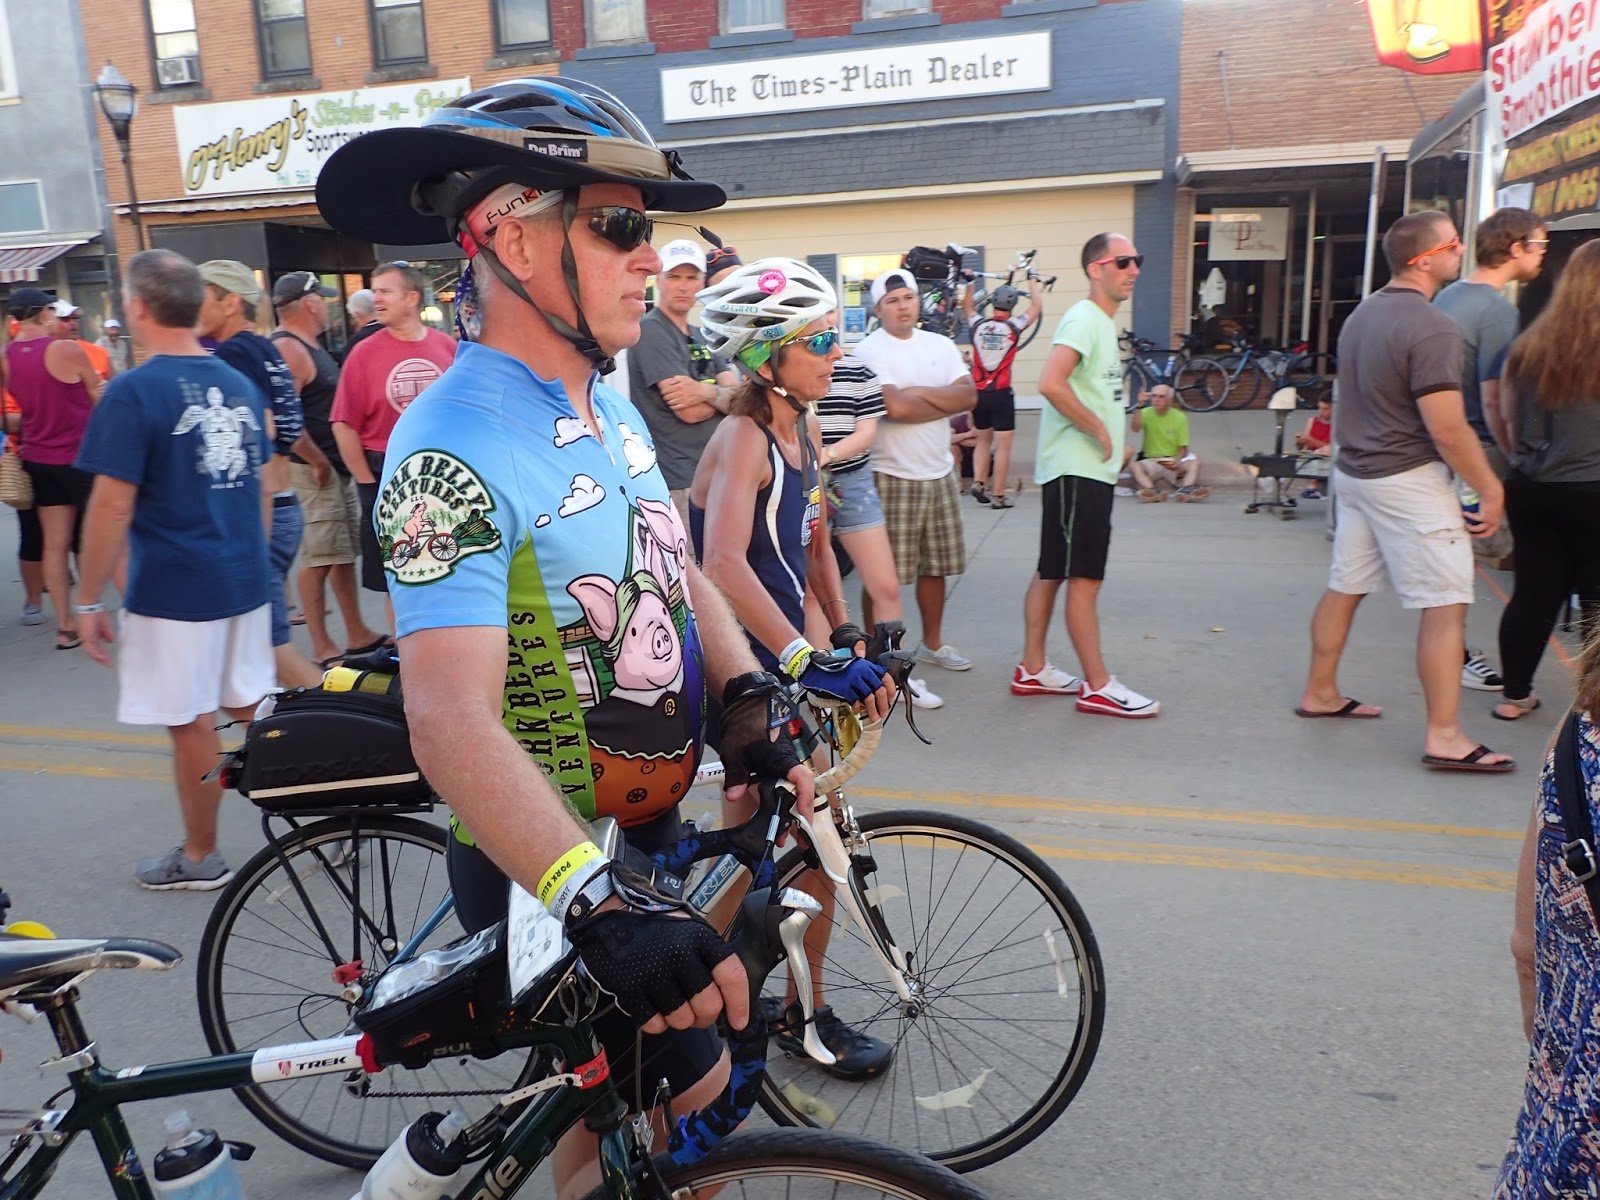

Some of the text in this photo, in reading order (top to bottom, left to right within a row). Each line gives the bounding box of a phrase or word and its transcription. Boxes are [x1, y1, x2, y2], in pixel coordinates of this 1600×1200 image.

[689, 53, 1019, 107] The Times-Plain Dealer
[730, 304, 759, 314] GIRO
[417, 454, 488, 507] BELLY
[386, 477, 466, 521] VENTURES
[410, 495, 424, 503] LLC
[550, 860, 572, 883] PORK
[557, 885, 572, 905] 2017
[296, 1055, 348, 1072] TREK
